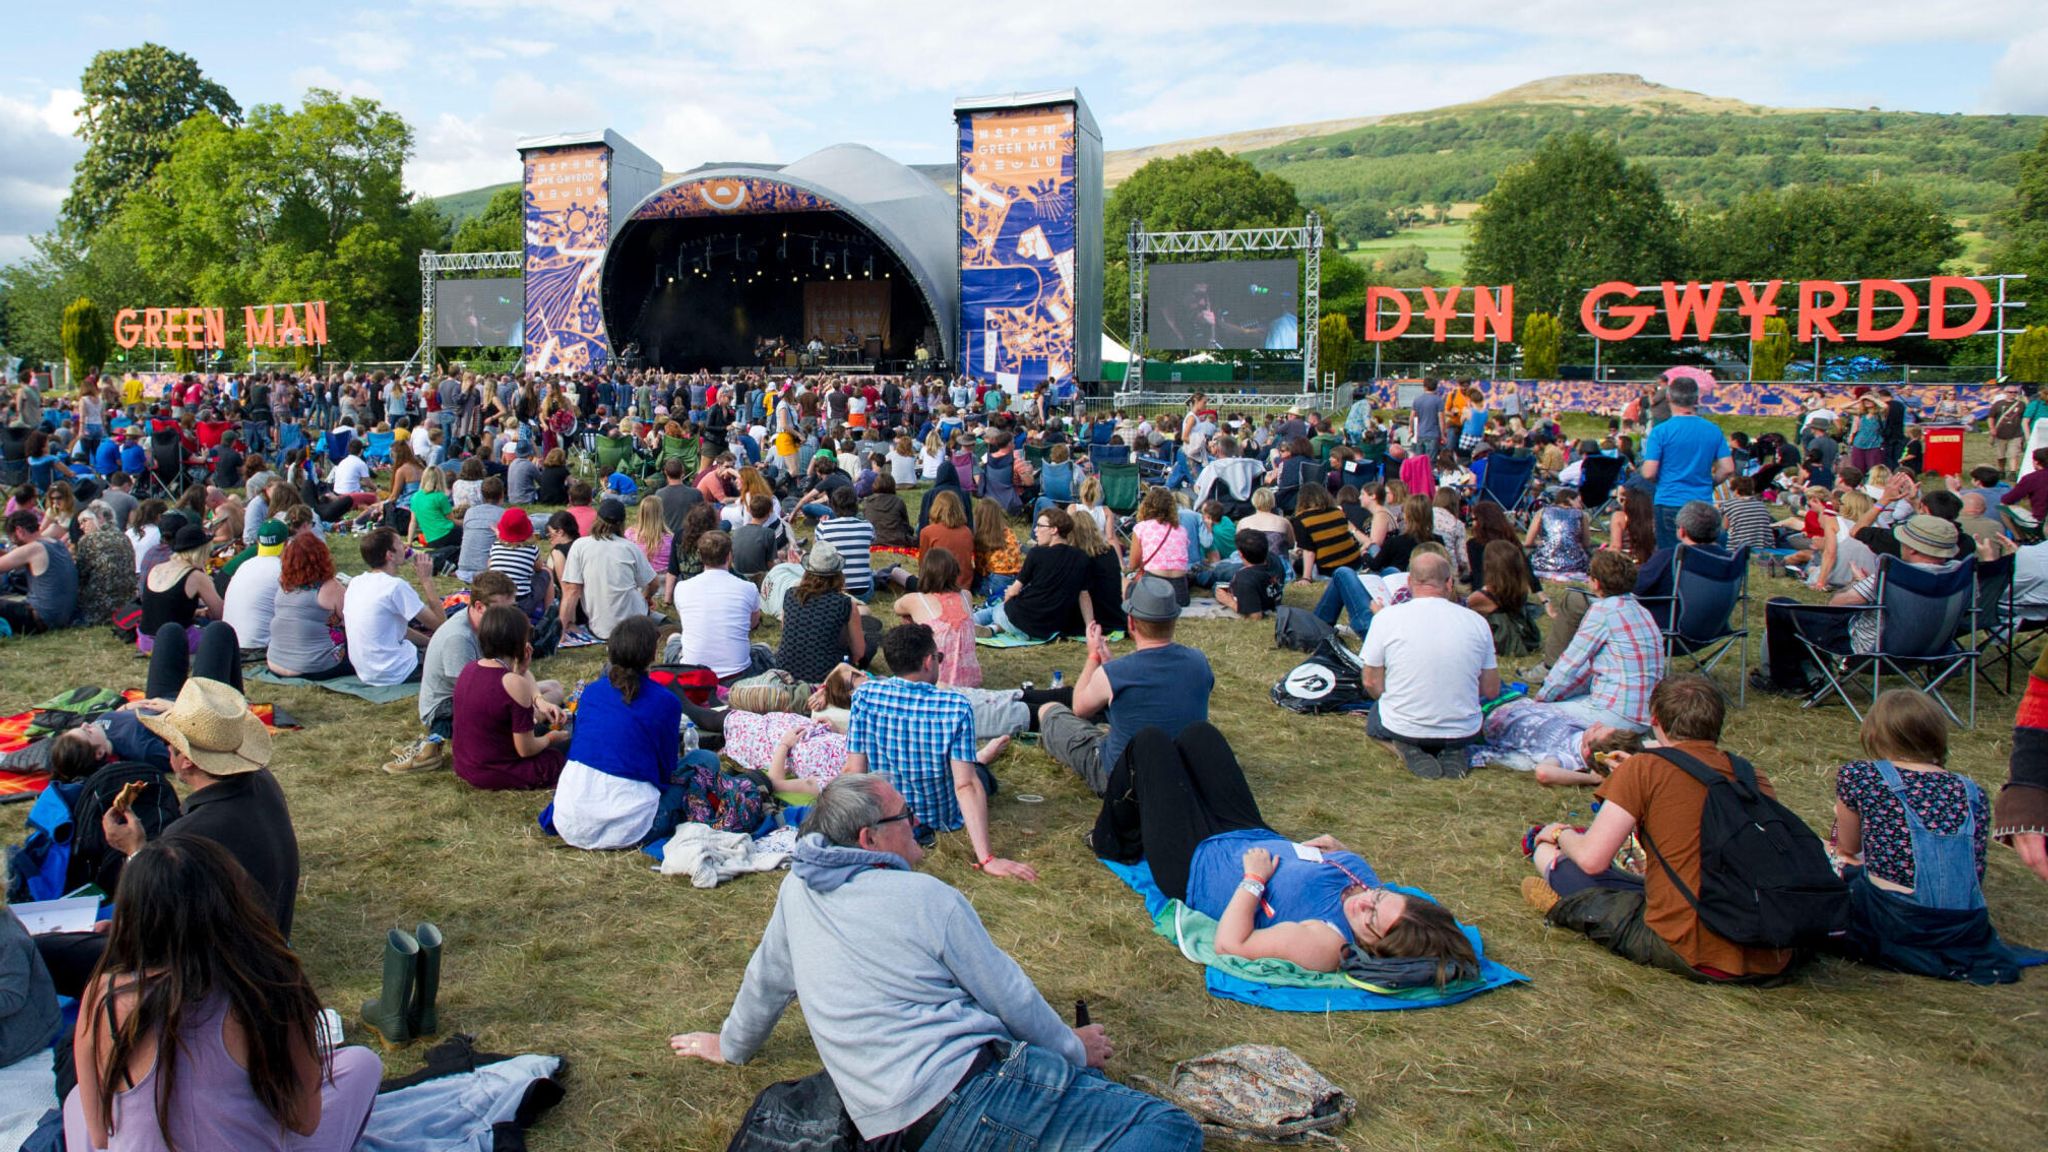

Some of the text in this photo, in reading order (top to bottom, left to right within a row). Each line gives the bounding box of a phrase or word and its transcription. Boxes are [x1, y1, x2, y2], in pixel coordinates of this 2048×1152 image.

[979, 140, 1056, 155] GREEN MAN
[115, 300, 327, 350] GREEN MAN
[1365, 276, 1992, 342] DYN GWYRDD
